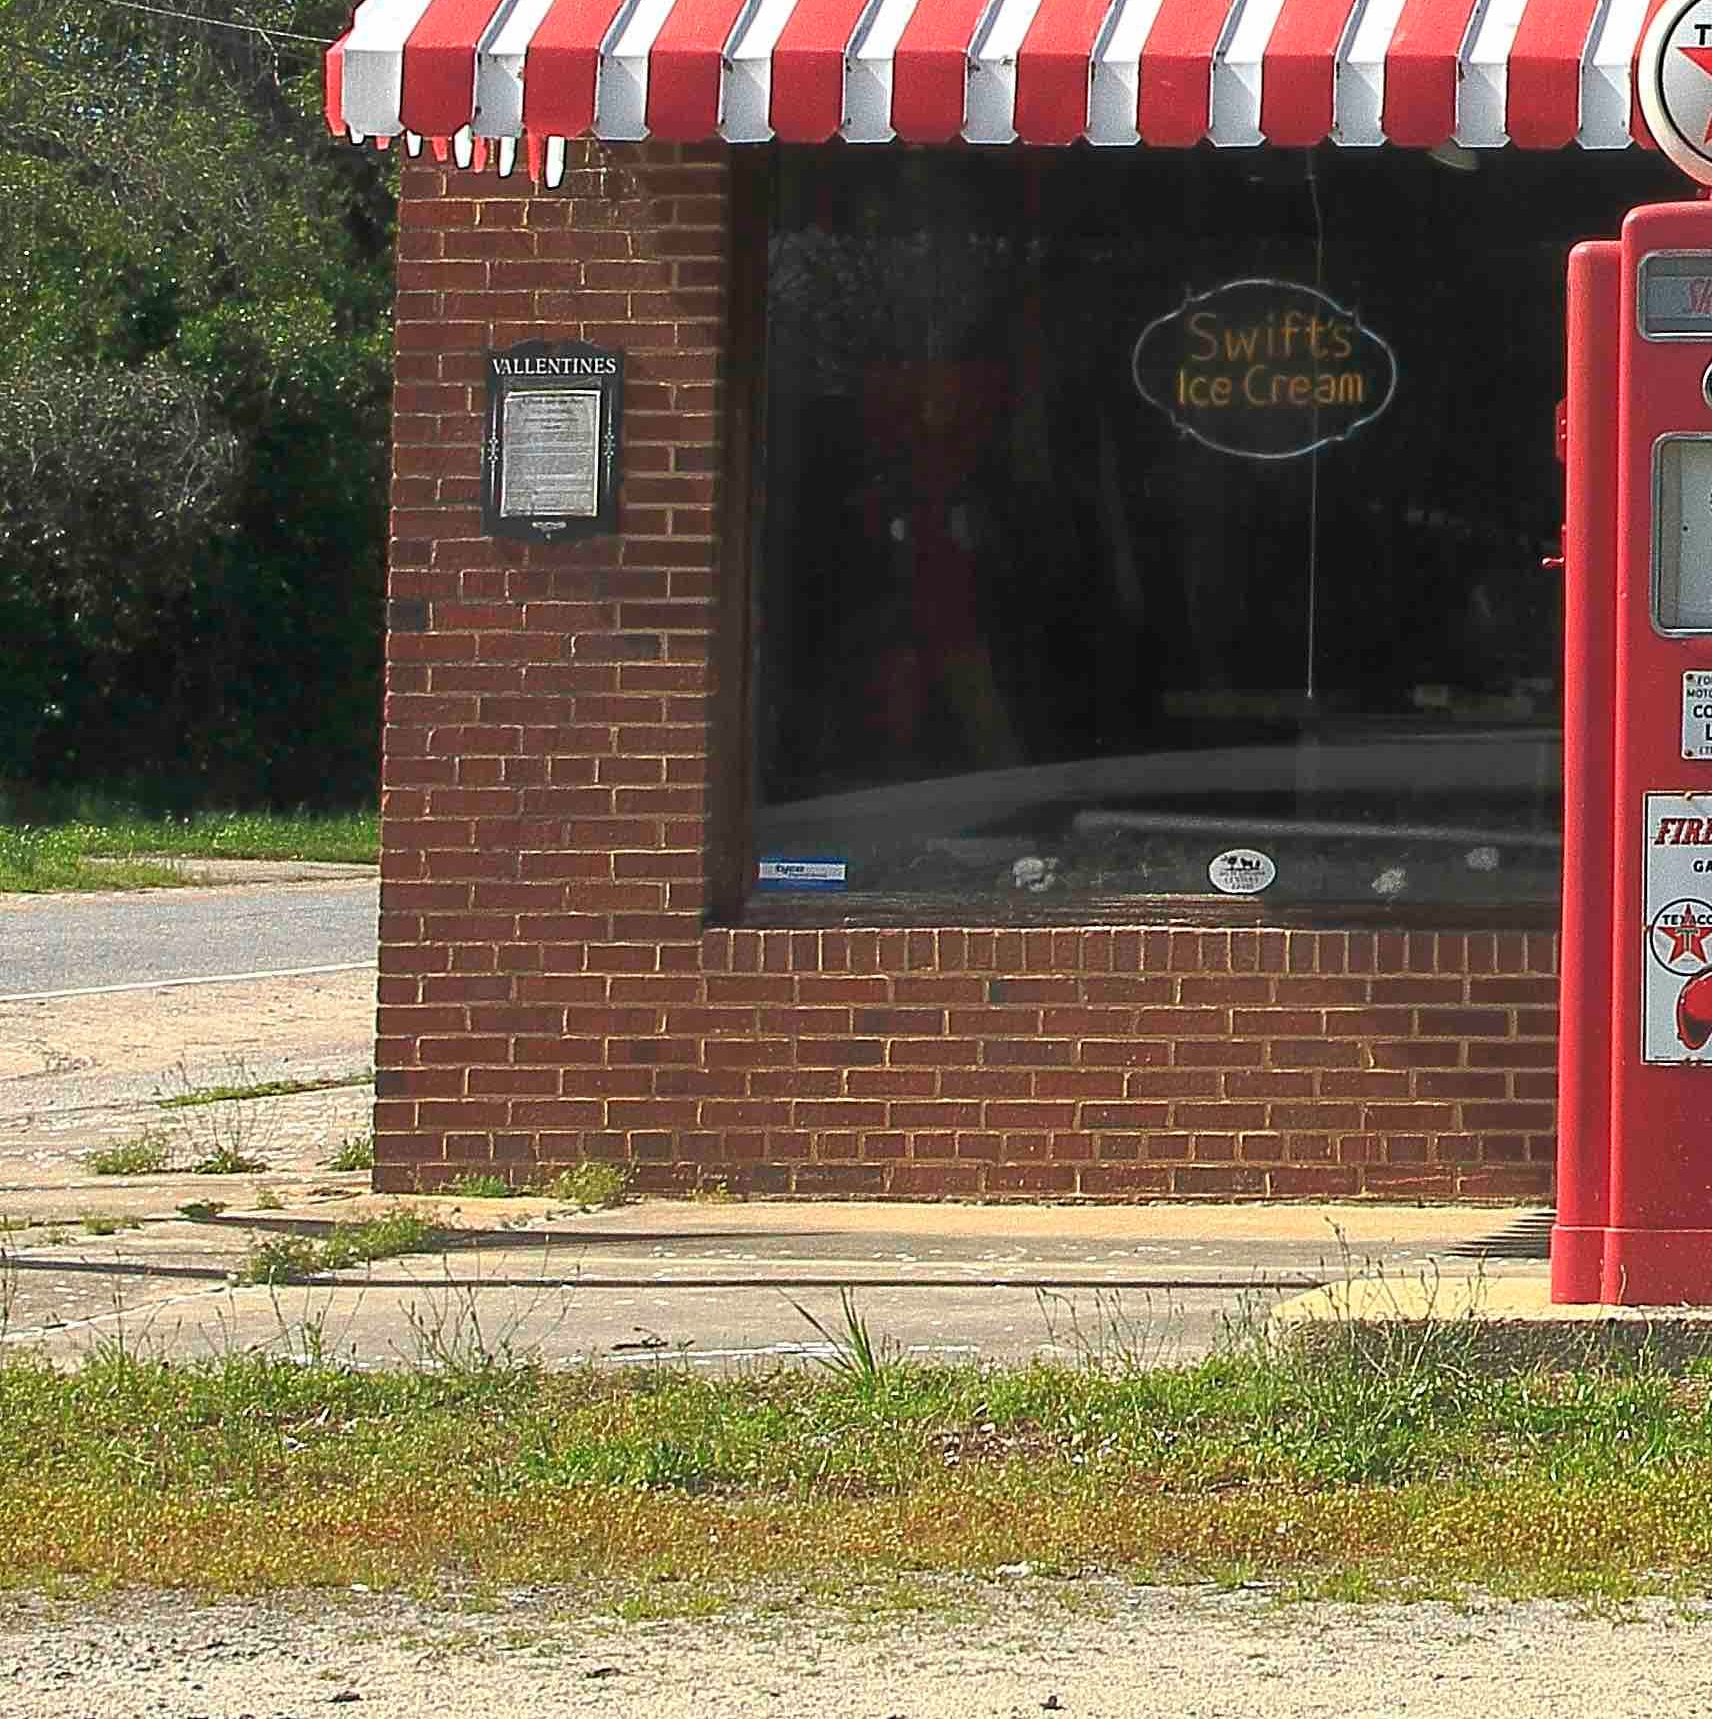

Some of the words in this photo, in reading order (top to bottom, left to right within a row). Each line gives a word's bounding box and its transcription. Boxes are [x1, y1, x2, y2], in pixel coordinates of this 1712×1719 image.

[1186, 310, 1353, 362] Swift's
[491, 358, 617, 375] VALLENTINES
[1176, 368, 1233, 406] Ice
[1243, 364, 1364, 407] Cream
